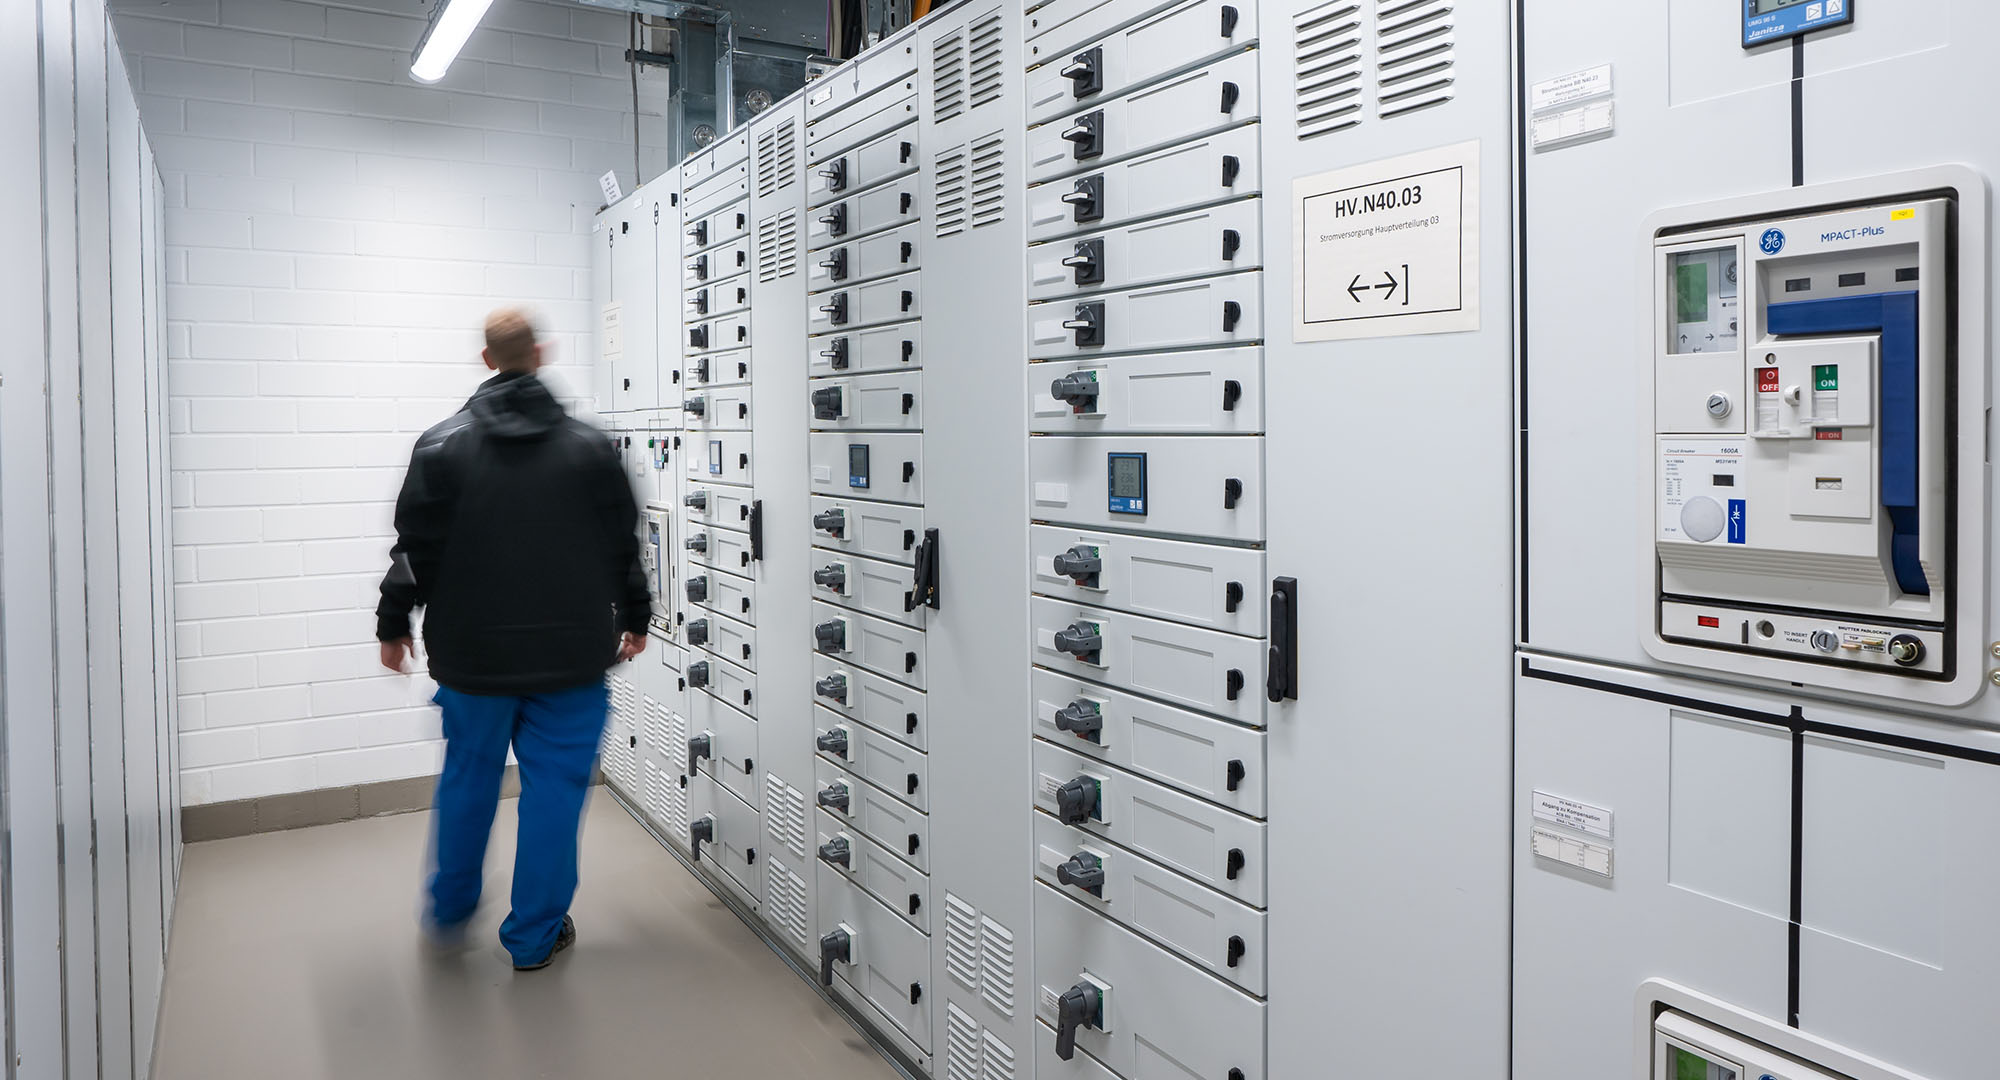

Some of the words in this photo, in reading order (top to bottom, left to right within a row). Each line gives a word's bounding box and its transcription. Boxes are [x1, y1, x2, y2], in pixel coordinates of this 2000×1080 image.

[1749, 24, 1785, 37] Janitza
[1335, 185, 1422, 218] HV.N40.03
[1320, 227, 1374, 243] Stromversorgung
[1374, 218, 1429, 234] Hauptverteilung
[1429, 215, 1440, 225] 03
[1820, 226, 1885, 243] MPACT-Plus
[1761, 383, 1779, 391] OFF
[1820, 379, 1836, 387] ON
[1861, 628, 1891, 636] PADLOCKING
[1542, 801, 1560, 811] Abgang
[1566, 807, 1601, 821] Kompensation
